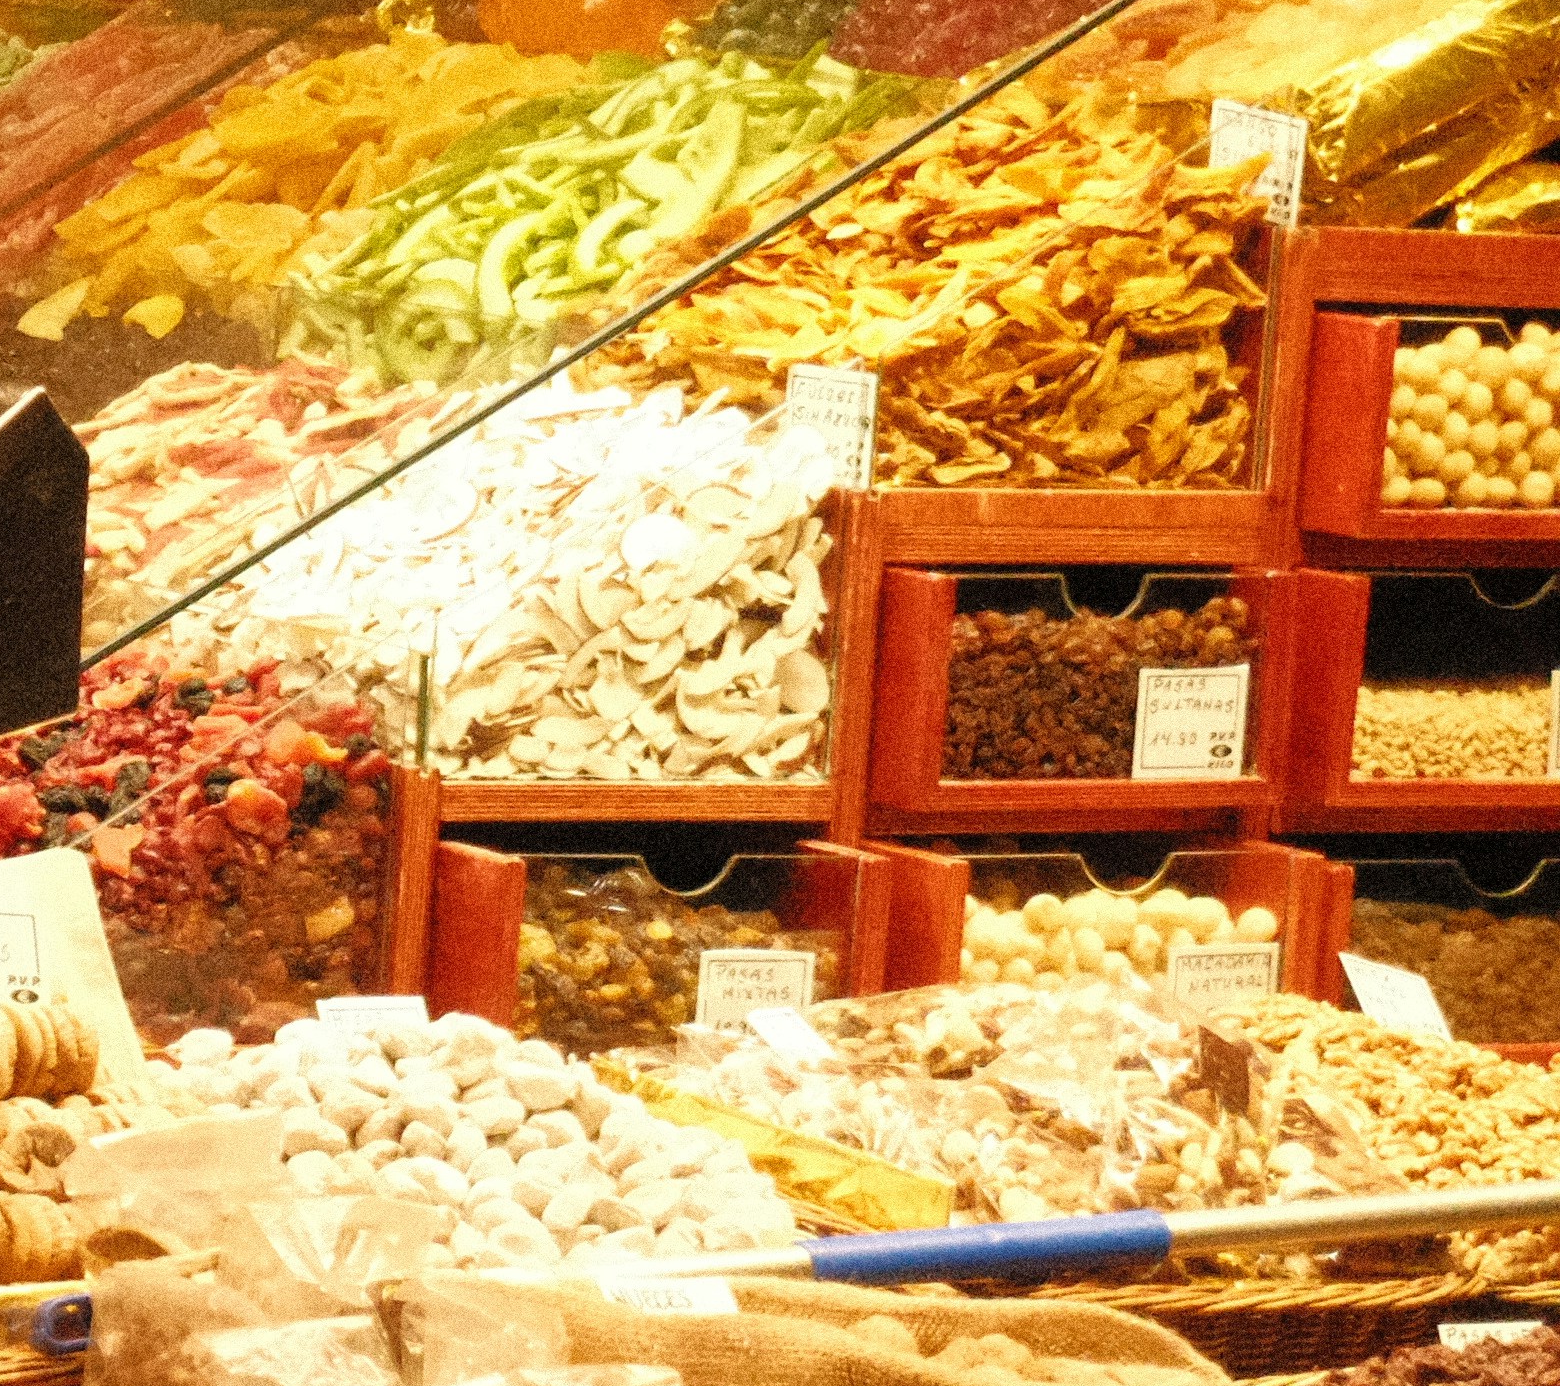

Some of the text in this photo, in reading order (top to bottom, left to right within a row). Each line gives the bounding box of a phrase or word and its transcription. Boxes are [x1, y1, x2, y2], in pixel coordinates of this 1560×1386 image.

[1154, 677, 1207, 693] PASAS
[1148, 697, 1235, 714] SULTANAS
[1209, 731, 1236, 741] PVP
[1180, 954, 1271, 973] MACADAMIA
[714, 963, 775, 983] PASAS
[722, 984, 791, 1001] MIXTAS
[1187, 974, 1263, 994] NATURAL
[606, 1287, 694, 1311] NUECES
